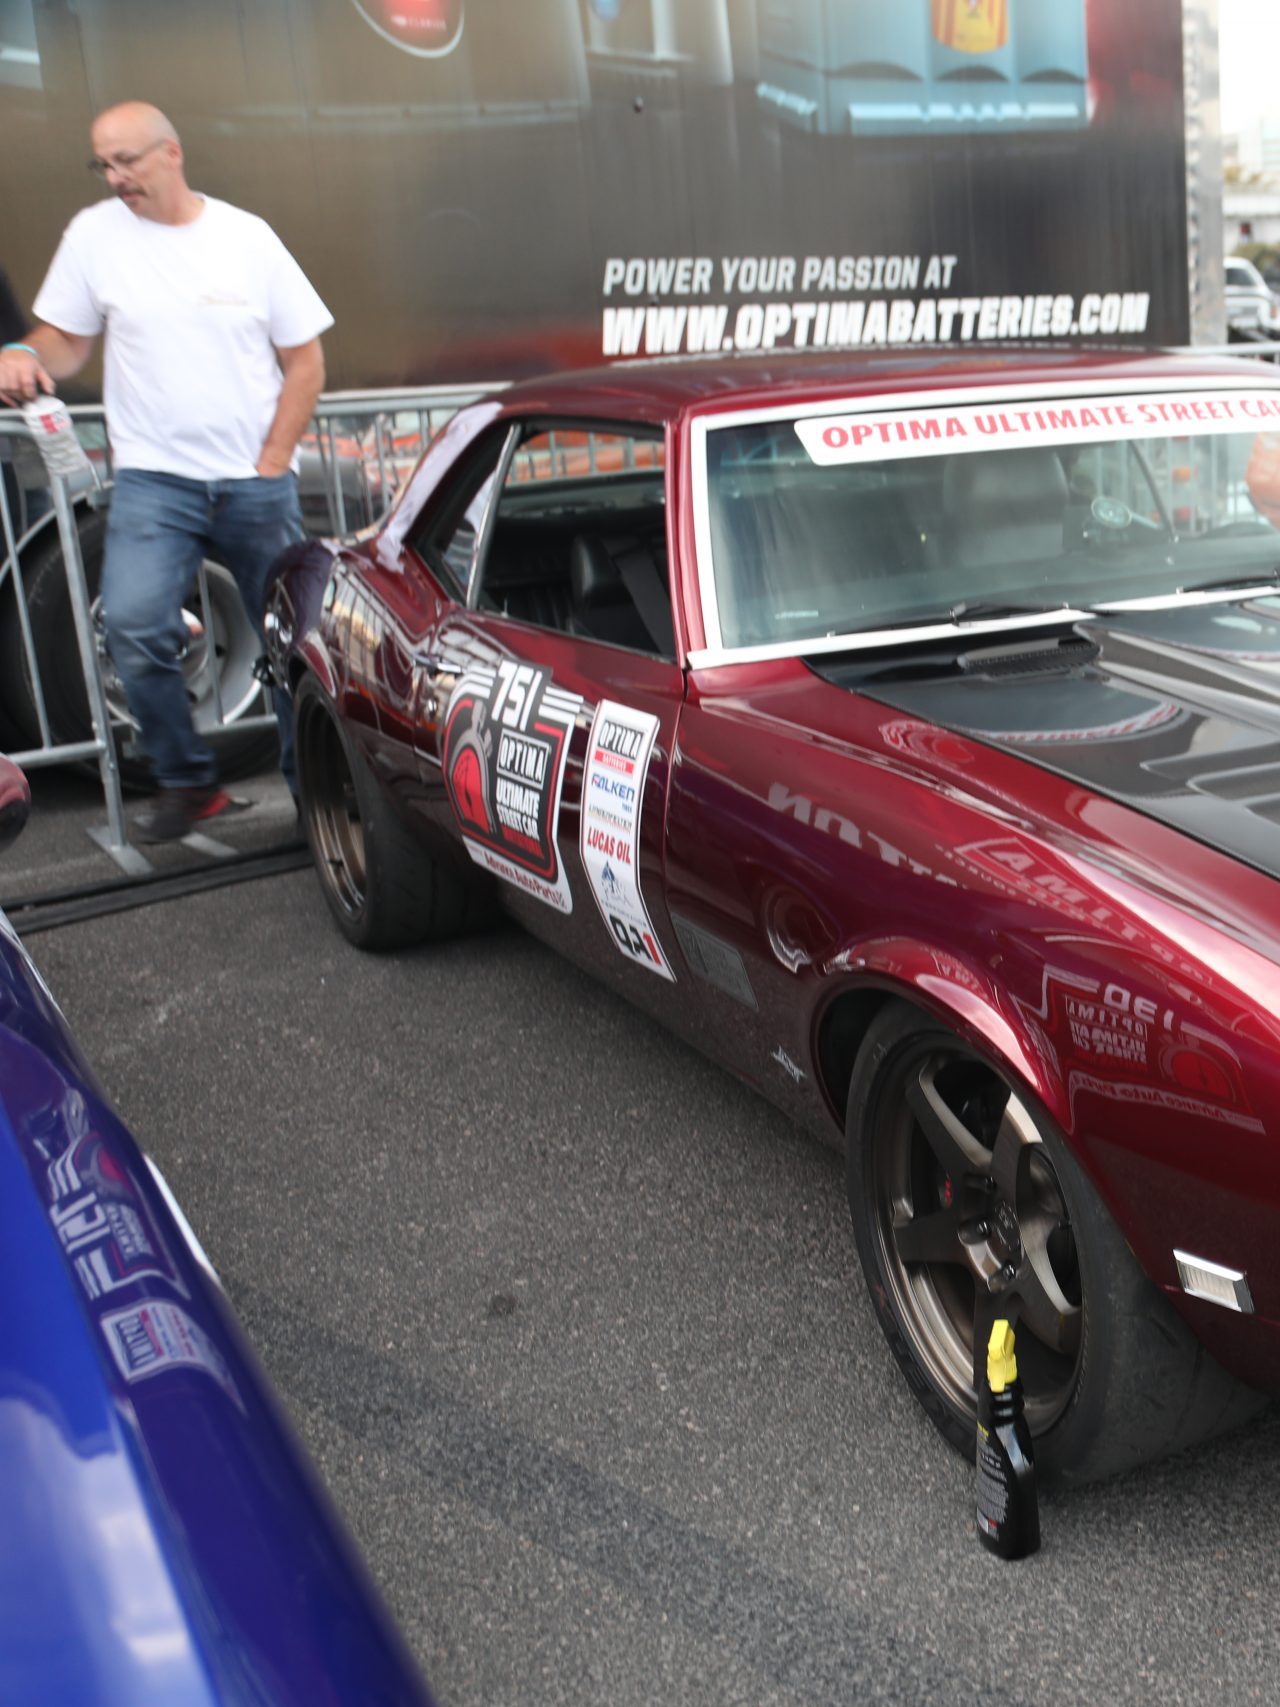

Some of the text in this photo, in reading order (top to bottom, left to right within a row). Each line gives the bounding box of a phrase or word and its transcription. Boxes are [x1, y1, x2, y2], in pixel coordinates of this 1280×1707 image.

[603, 255, 957, 296] POWER YOUR PASSION AT
[602, 293, 1150, 355] WWW.OPTIMABATTERIES.COM
[822, 416, 969, 449] OPTIMA
[974, 405, 1134, 435] ULTIMATE
[1138, 400, 1236, 423] STREET
[499, 736, 545, 783] OPTIMA
[598, 720, 644, 760] OPTIMA
[496, 777, 540, 820] ULTIMATE
[496, 802, 541, 841] STREET CAR
[587, 826, 632, 865] LUCAS OIL
